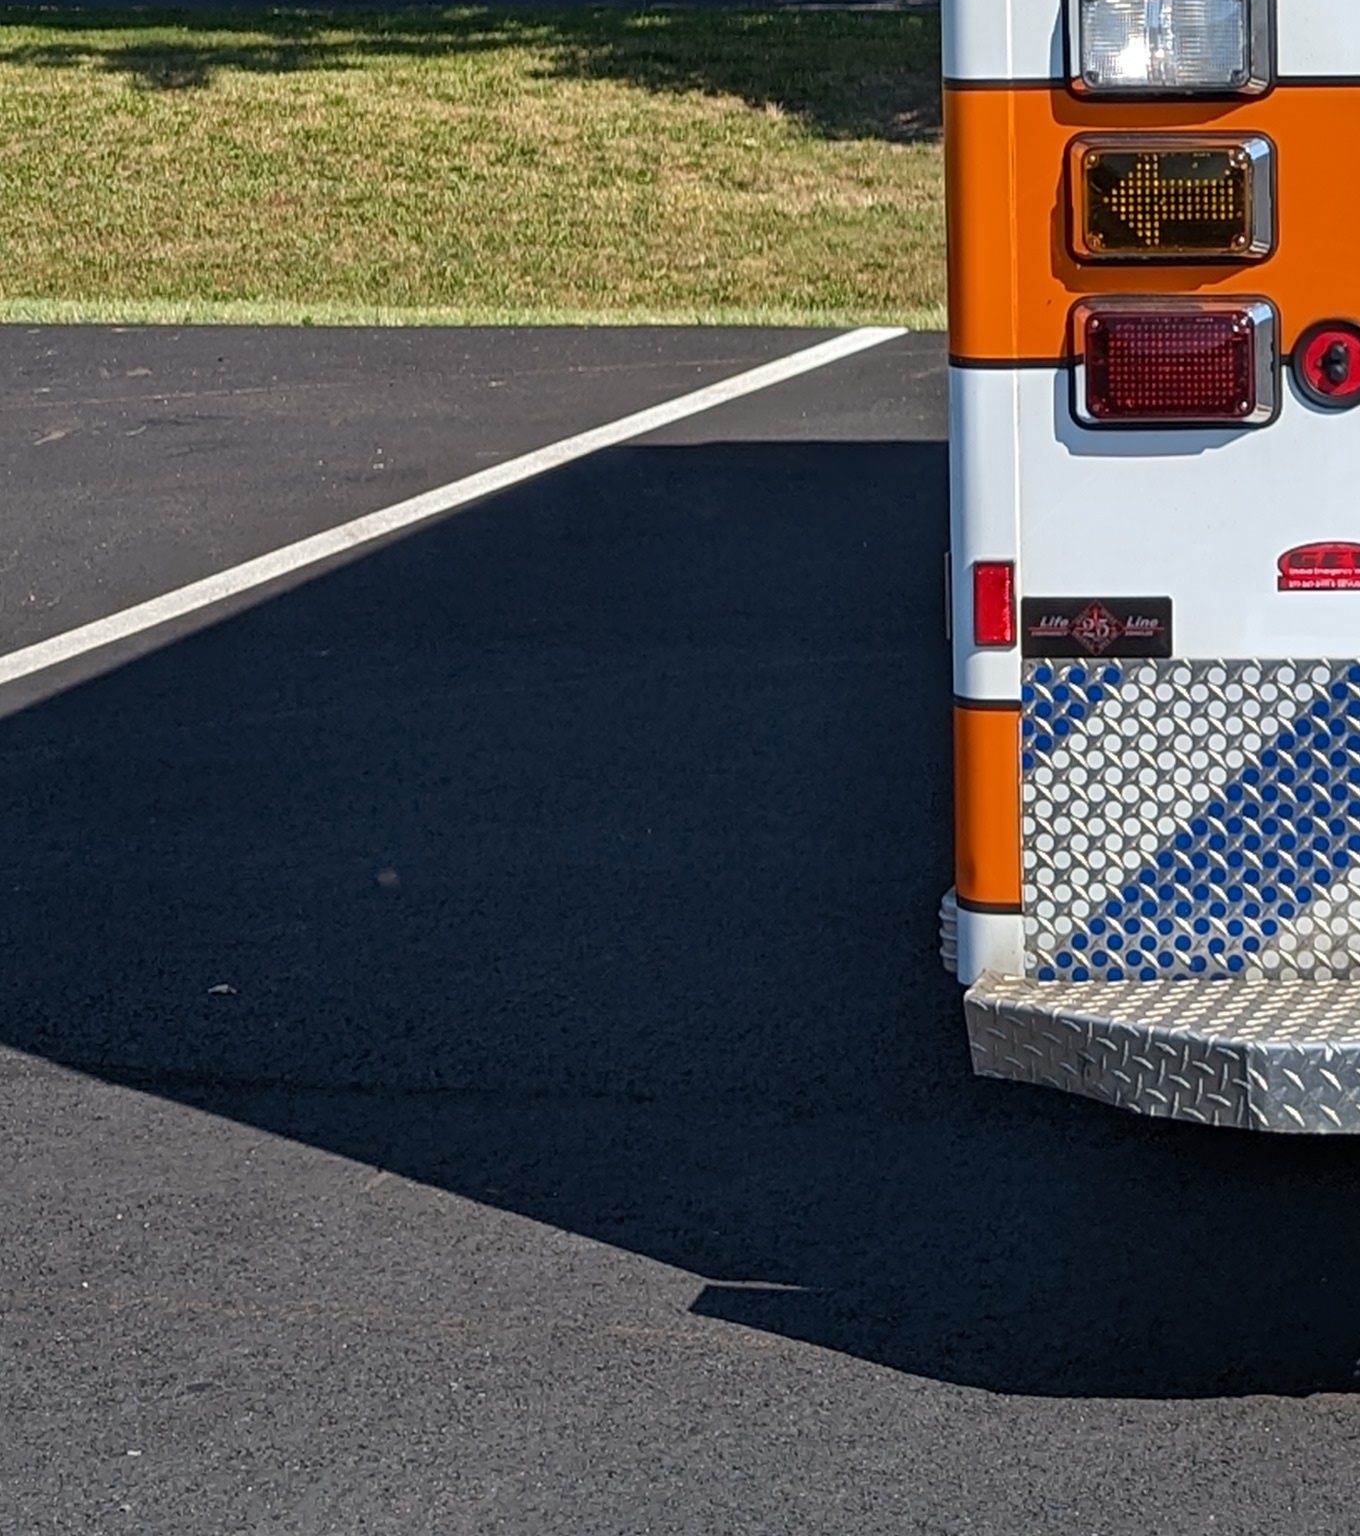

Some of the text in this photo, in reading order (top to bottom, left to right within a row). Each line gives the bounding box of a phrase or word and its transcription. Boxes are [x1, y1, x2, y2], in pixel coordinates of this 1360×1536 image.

[1040, 615, 1069, 627] Life
[1081, 617, 1110, 640] 25
[1126, 615, 1159, 628] Line
